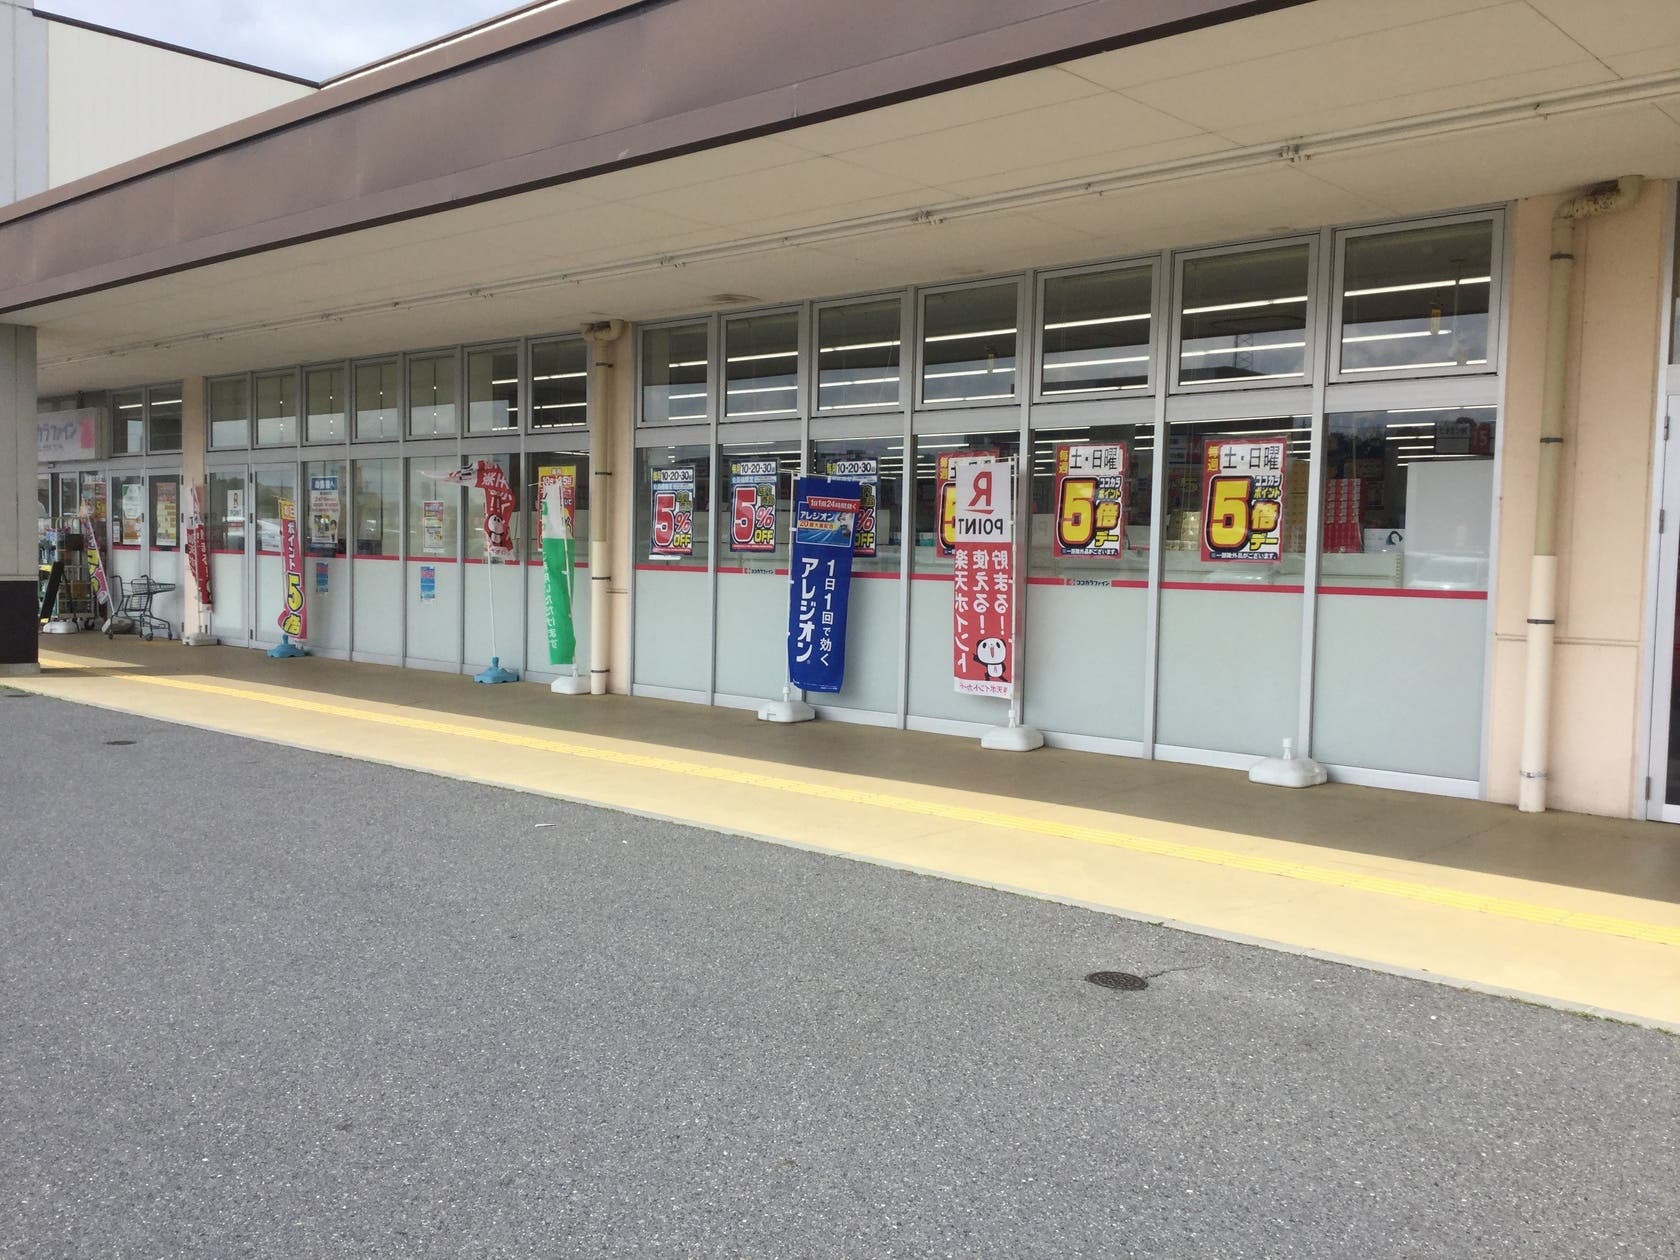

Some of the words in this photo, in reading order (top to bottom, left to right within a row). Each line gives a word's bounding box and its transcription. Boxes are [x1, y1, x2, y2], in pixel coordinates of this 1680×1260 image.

[1070, 448, 1119, 470] 土・日曜
[1222, 446, 1281, 470] 土・日曜
[799, 510, 835, 522] アレジオン
[672, 534, 691, 547] OFF
[753, 529, 774, 543] OFF
[796, 557, 819, 663] アレジオン
[819, 559, 836, 667] 1日1回で効く
